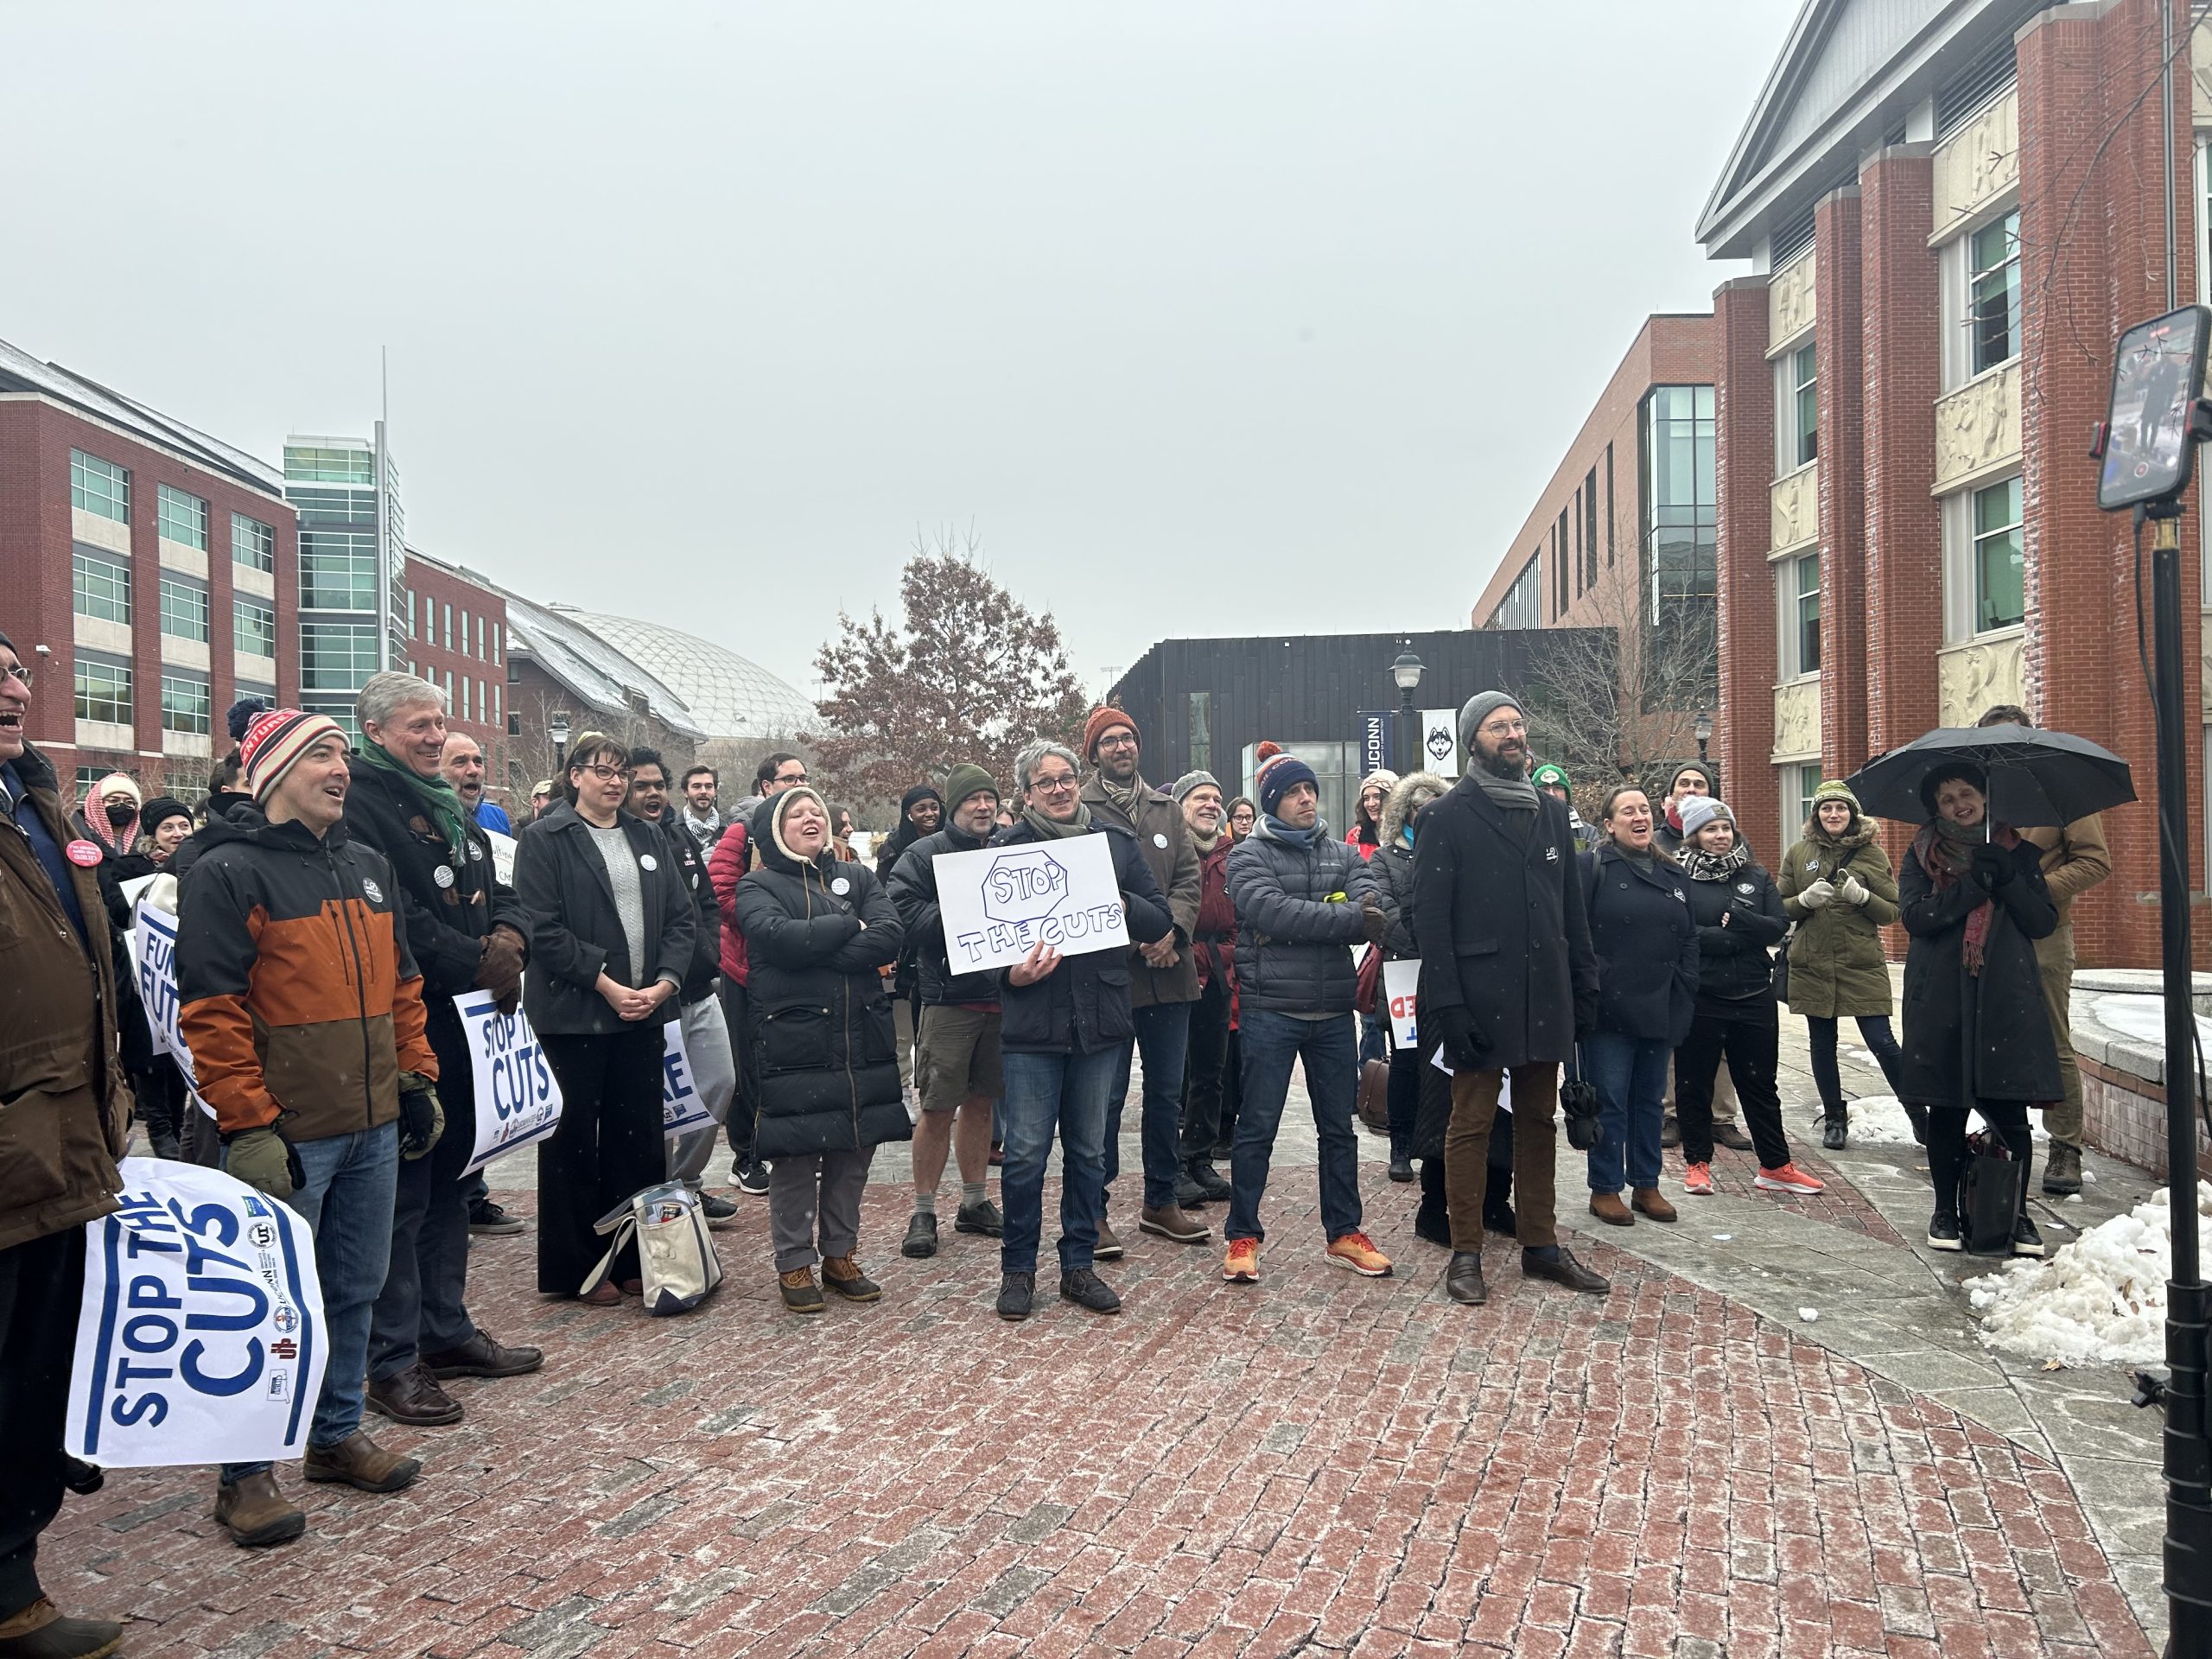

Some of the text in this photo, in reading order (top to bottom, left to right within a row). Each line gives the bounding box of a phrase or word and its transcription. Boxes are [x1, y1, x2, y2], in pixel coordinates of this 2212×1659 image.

[1368, 718, 1381, 772] UCONN
[989, 861, 1065, 904] STOP
[146, 931, 176, 982] FUN
[957, 903, 1122, 963] THE CUTS
[482, 1012, 516, 1058] STOP
[493, 1042, 550, 1121] CUTS
[111, 1192, 182, 1427] STOP THE
[167, 1197, 270, 1397] CUTS
